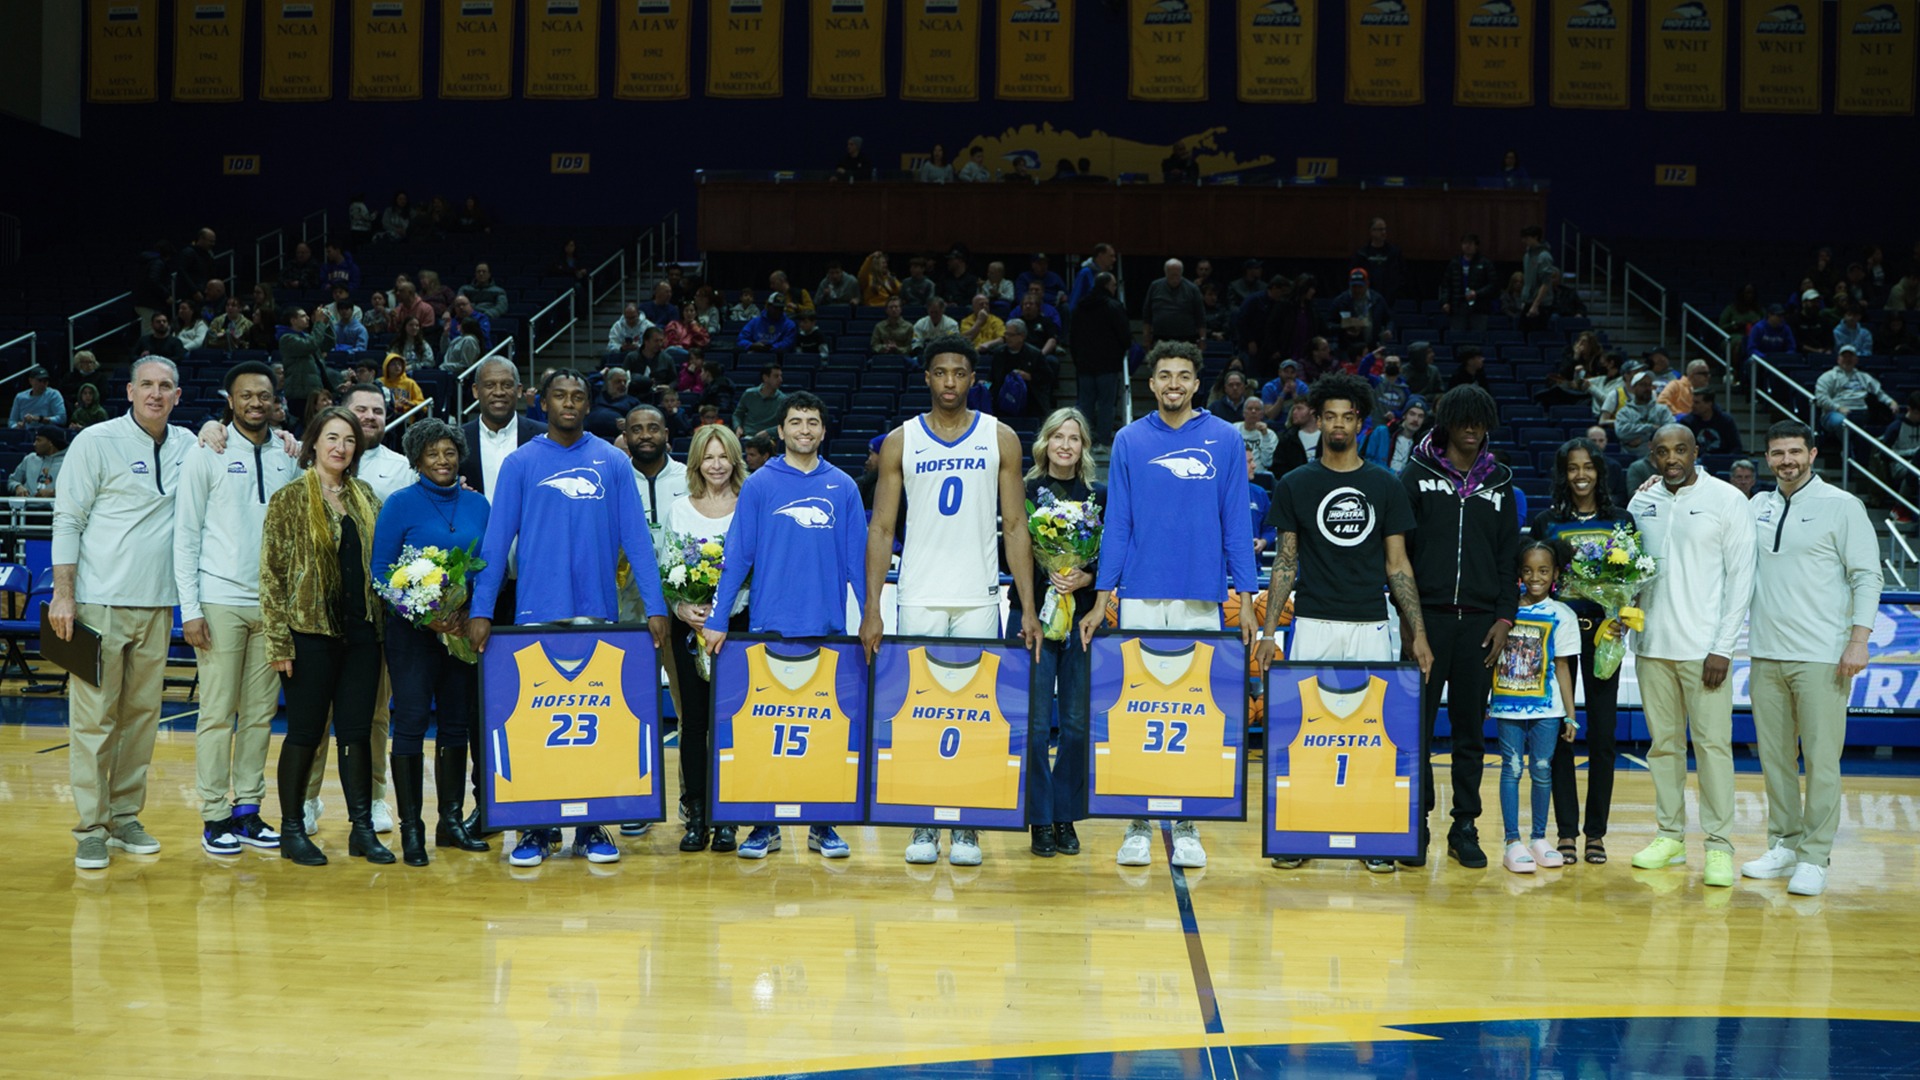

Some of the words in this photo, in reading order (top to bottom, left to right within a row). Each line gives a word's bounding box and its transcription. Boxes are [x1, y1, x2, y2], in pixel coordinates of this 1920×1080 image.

[188, 24, 230, 36] NCAA
[277, 23, 318, 35] NCAA
[367, 22, 408, 34] NCAA
[456, 20, 498, 32] NCAA
[541, 20, 583, 32] NCAA
[628, 18, 679, 31] AIAW
[728, 18, 763, 31] NIT
[825, 18, 870, 30] NCAA
[919, 19, 964, 31] NCAA
[103, 26, 142, 37] NCAA
[1018, 30, 1053, 42] NIT
[1152, 31, 1186, 43] NIT
[1252, 33, 1303, 45] WNIT
[1368, 34, 1403, 46] NIT
[1467, 35, 1522, 48] WNIT
[1567, 37, 1615, 50] WNIT
[1663, 39, 1710, 51] WNIT
[1758, 40, 1805, 53] WNIT
[1859, 42, 1895, 55] NIT
[229, 158, 254, 170] 108
[557, 157, 583, 169] 109
[1308, 162, 1327, 175] 111
[1664, 168, 1687, 181] 112
[916, 458, 985, 474] HOFSTRA
[938, 476, 963, 516] 0
[1330, 510, 1363, 520] HOFSTRA
[1333, 524, 1341, 533] 4
[1341, 524, 1359, 533] ALL
[531, 694, 611, 709] HOFSTRA
[1127, 700, 1206, 715] HOFSTRA
[752, 704, 832, 719] HOFSTRA
[912, 706, 991, 722] HOFSTRA
[545, 712, 599, 748] 23
[1142, 719, 1189, 754] 32
[772, 722, 811, 758] 15
[938, 726, 962, 760] 0
[1303, 734, 1382, 748] HOFSTRA
[1334, 753, 1349, 787] 1
